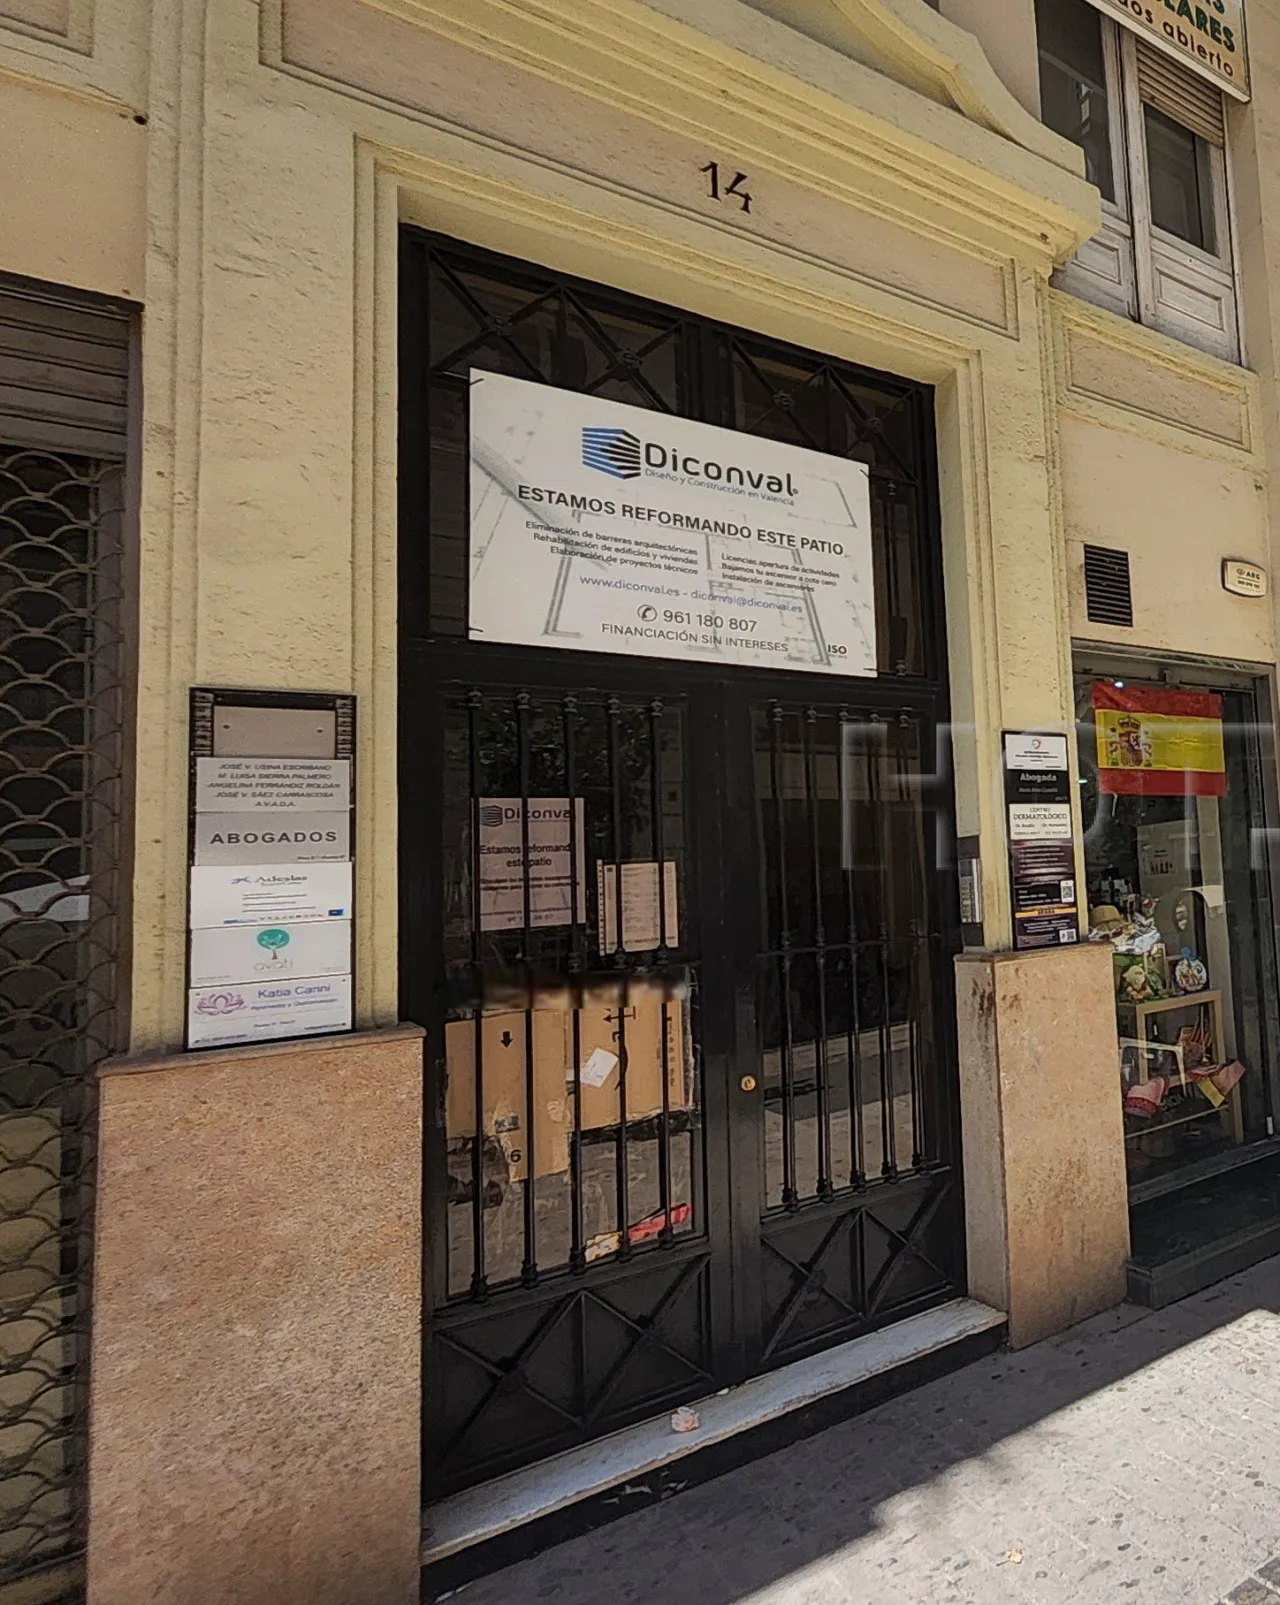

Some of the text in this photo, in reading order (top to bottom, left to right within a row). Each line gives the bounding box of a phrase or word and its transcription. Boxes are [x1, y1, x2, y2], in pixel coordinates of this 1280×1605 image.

[1157, 0, 1235, 52] LARES
[1163, 21, 1234, 77] abierto
[699, 161, 752, 214] 14
[644, 442, 793, 497] Diconval
[645, 468, 794, 506] Diseño y Construcción en Valencia
[518, 484, 844, 555] ESTAMOS REFORMANDO ESTE PATIO
[526, 521, 697, 555] Eliminación de barreras arquitectónicas
[534, 533, 698, 565] Rehabilitación de edificios y viviendas
[550, 546, 698, 575] Elaboración de proyectos técnicos
[722, 563, 754, 575] Bajamos
[765, 571, 797, 582] ascensor
[758, 559, 789, 571] apertura
[791, 564, 800, 572] de
[722, 572, 762, 585] Instalación
[765, 578, 774, 586] de
[580, 576, 680, 598] www.diconval.es
[691, 590, 803, 613] diconval@diconval.es
[663, 609, 758, 632] 961 180 807
[601, 622, 789, 652] FINANCIACIÓN SIN INTERESES
[828, 644, 847, 654] ISO
[1020, 773, 1056, 783] Abogada
[504, 808, 572, 820] Diconva
[210, 831, 337, 844] ABOGADOS
[258, 984, 331, 999] Katia Carini
[510, 1148, 521, 1164] 6
